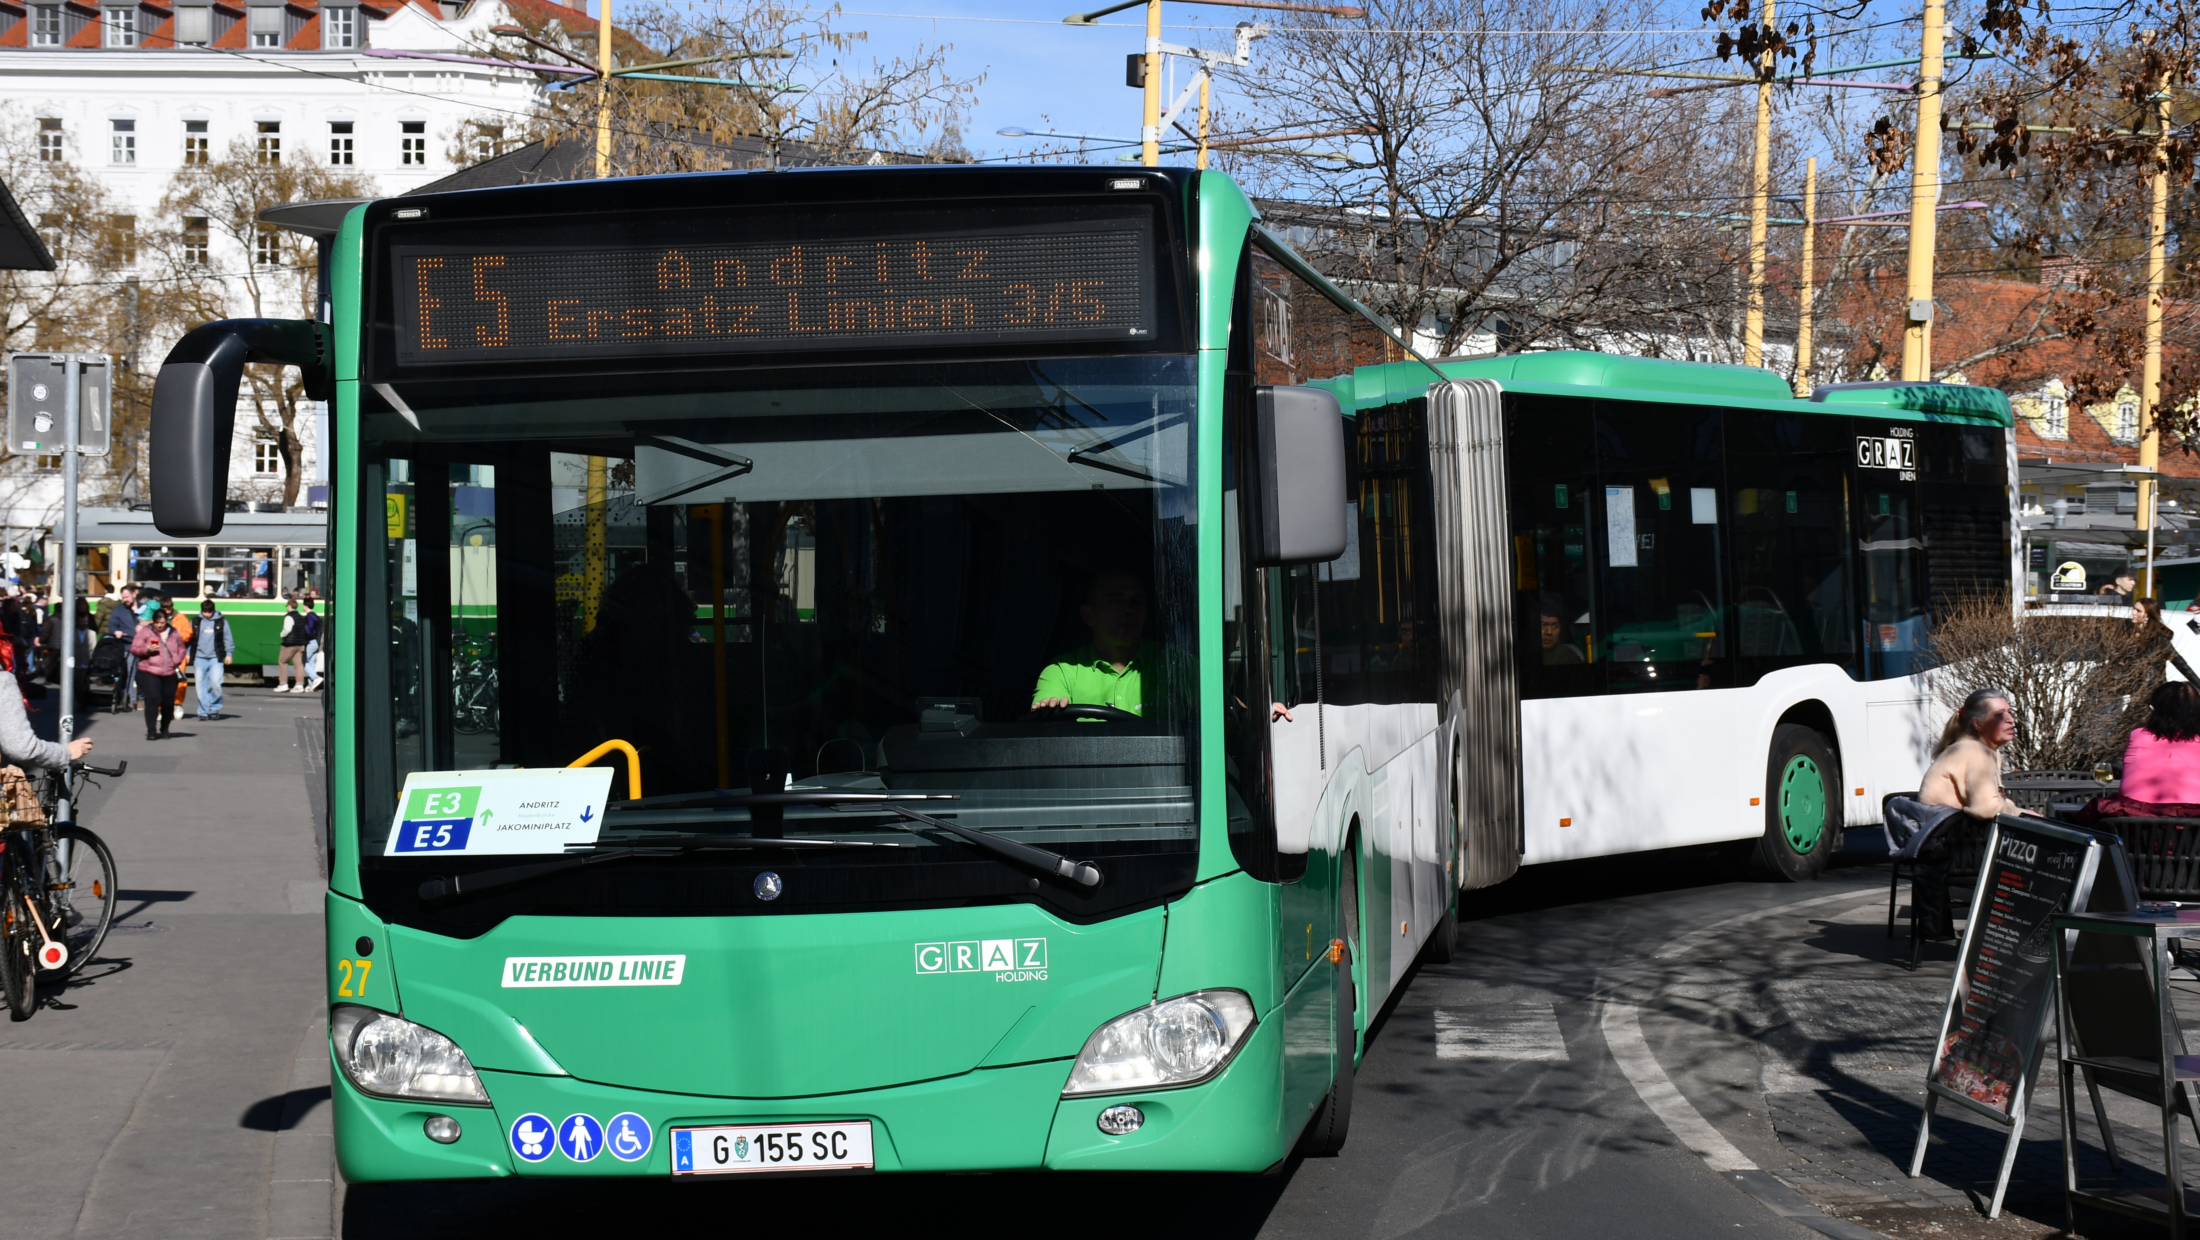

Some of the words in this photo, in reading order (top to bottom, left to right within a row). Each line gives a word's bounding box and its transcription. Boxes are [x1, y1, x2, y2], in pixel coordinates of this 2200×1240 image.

[657, 241, 990, 290] Andritz
[417, 256, 509, 349] E5
[547, 295, 760, 340] Ersatz
[788, 289, 975, 331] Linien
[1003, 281, 1106, 324] 3/5
[1889, 427, 1914, 438] HOLDING
[1858, 439, 1914, 467] GRAZ
[423, 792, 462, 815] E3
[519, 801, 560, 809] ANDRITZ
[413, 824, 453, 848] E5
[496, 822, 572, 831] JAKOMINIPLATZ
[1998, 830, 2038, 865] Pizza
[917, 940, 1043, 972] GRAZ
[337, 958, 373, 998] 27
[511, 961, 614, 982] VERBUND
[618, 959, 677, 981] LINIE
[995, 970, 1049, 983] HOLDING
[680, 1155, 690, 1166] A
[713, 1135, 730, 1165] G
[753, 1132, 804, 1163] 155
[811, 1130, 848, 1161] SC
